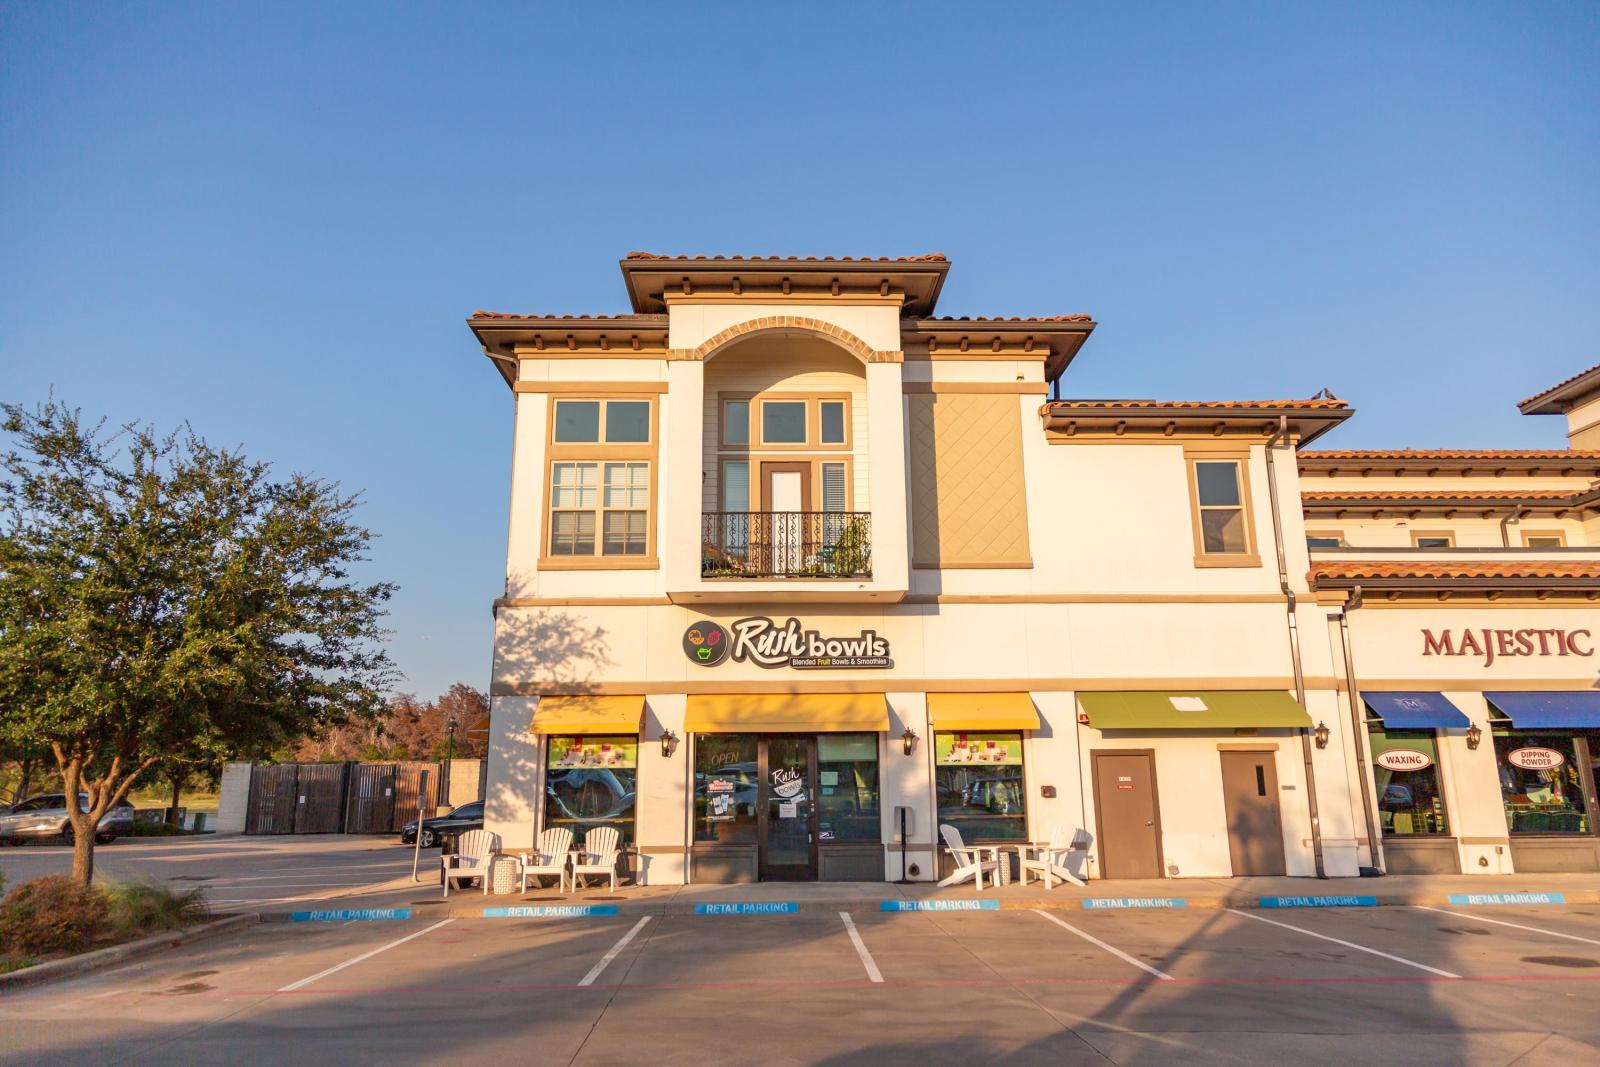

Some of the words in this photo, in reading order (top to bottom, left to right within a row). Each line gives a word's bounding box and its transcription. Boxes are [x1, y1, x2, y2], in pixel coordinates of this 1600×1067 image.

[735, 619, 806, 664] Rush
[810, 634, 886, 657] bowls
[1421, 628, 1594, 667] MAJESTIC
[792, 658, 816, 666] Blended
[817, 658, 831, 666] Fruit
[832, 658, 850, 666] Bowls
[857, 657, 887, 665] Smoothies
[711, 751, 739, 766] OPEN
[1385, 755, 1422, 764] WAXING
[1521, 758, 1552, 766] POWDER
[772, 767, 799, 785] Rush
[1092, 899, 1127, 908] RETAIL
[1128, 898, 1173, 908] PARKING
[1278, 896, 1312, 906] RETAIL
[1312, 896, 1359, 905] PARKING
[1468, 895, 1503, 905] RETAIL
[1504, 894, 1550, 904] PARKING
[706, 904, 741, 914] RETAIL
[743, 903, 788, 913] PARKING
[899, 901, 934, 911] RETAIL
[935, 900, 980, 910] PARKING
[310, 910, 346, 920] RETAIL
[347, 909, 395, 919] PARKING
[507, 907, 544, 917] RETAIL
[545, 906, 591, 916] PARKING
